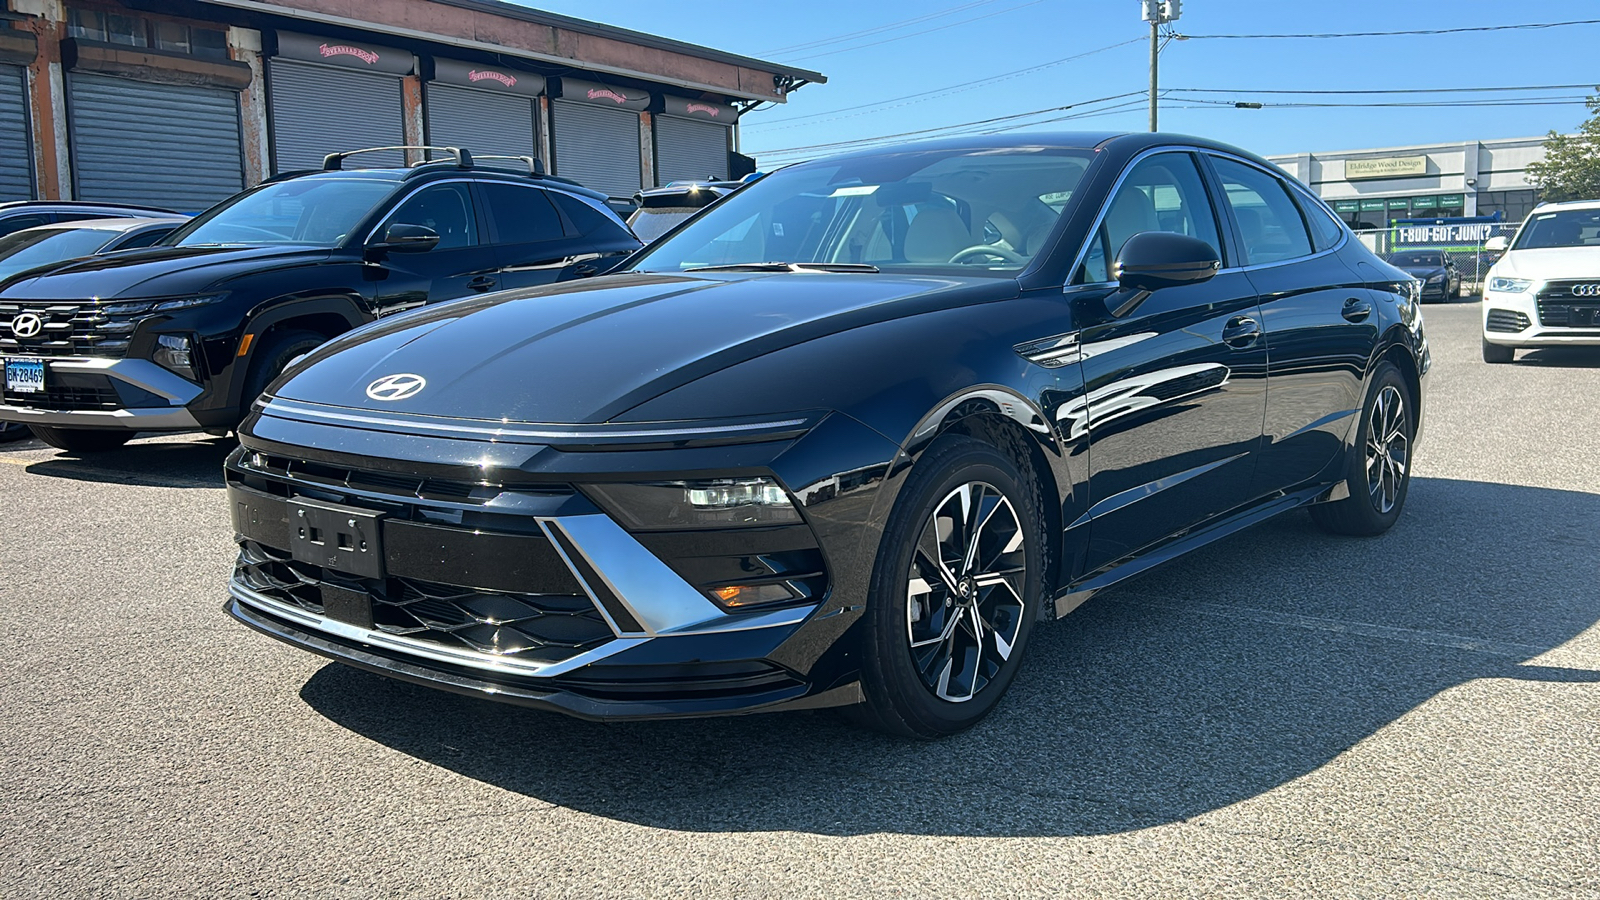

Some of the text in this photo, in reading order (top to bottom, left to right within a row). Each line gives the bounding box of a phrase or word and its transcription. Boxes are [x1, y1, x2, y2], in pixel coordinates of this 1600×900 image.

[325, 46, 357, 56] OVERHEAD
[1350, 162, 1377, 170] Eldridge
[1399, 225, 1492, 242] 1-800-GOT-JUNK?
